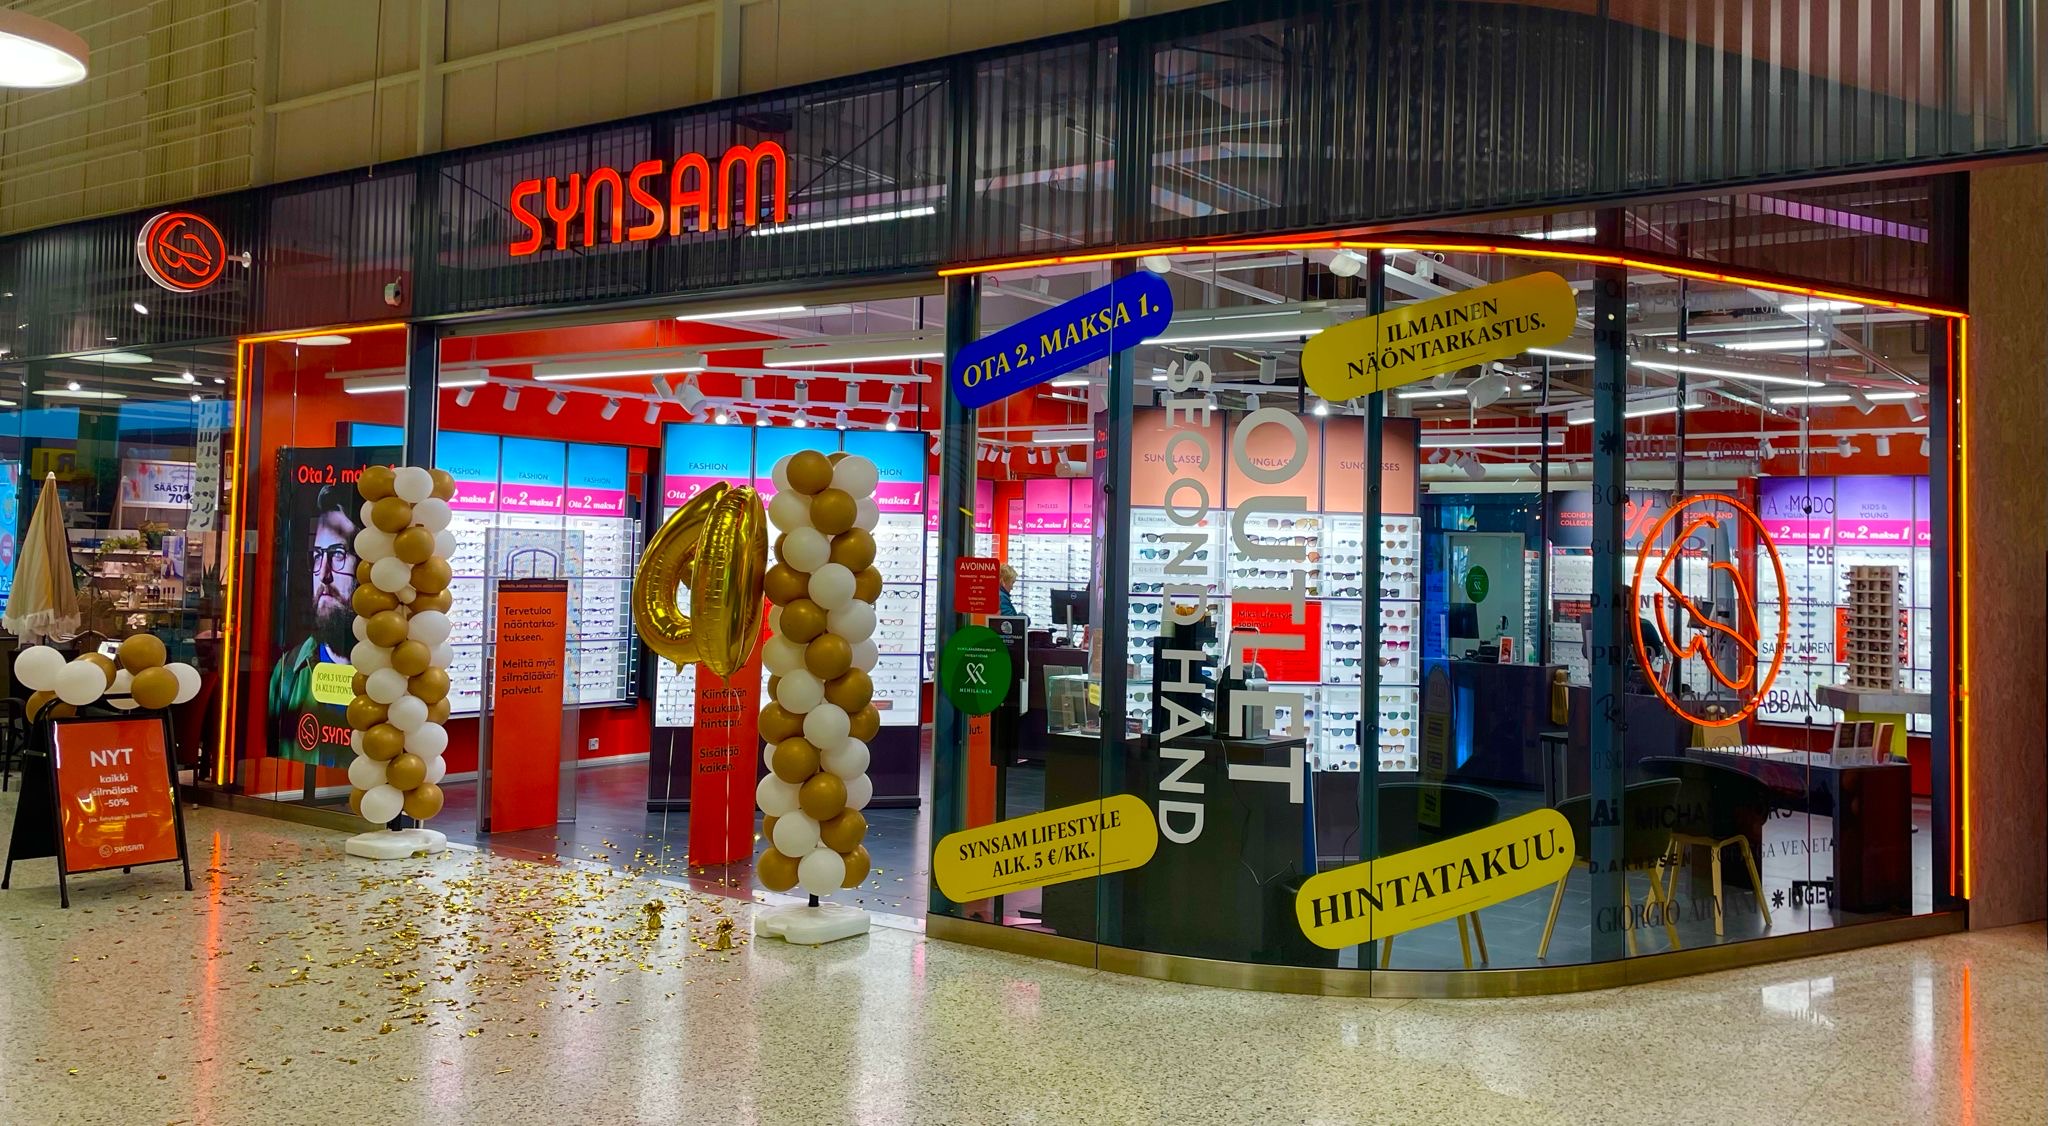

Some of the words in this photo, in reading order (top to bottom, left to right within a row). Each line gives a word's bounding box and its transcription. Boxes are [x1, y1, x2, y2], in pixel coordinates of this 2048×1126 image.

[509, 140, 788, 257] SYNSAM
[1386, 298, 1499, 343] ILMAINEN
[962, 352, 1011, 388] OTA
[1015, 343, 1035, 369] 2,
[1039, 302, 1131, 359] MAKSA
[1138, 292, 1159, 318] 1.
[1346, 312, 1546, 380] NÄÖNTARKASTUS.
[1144, 453, 1203, 464] SUNLASSE
[450, 467, 481, 476] FASHION
[689, 462, 728, 470] FASHION
[1340, 461, 1400, 471] SUNGSSES
[298, 465, 322, 484] Ota
[325, 464, 337, 486] 2,
[518, 472, 549, 481] FASHION
[583, 476, 611, 484] FASHION
[488, 490, 495, 504] 1
[667, 491, 687, 499] Ota
[688, 484, 701, 499] 2
[878, 496, 911, 505] maksa
[913, 491, 921, 506] 1
[1163, 359, 1212, 626] SECOND
[502, 497, 518, 505] Ota
[519, 491, 528, 506] 2
[530, 499, 554, 507] maksa
[555, 494, 563, 508] 1
[568, 501, 583, 509] Ota
[583, 496, 593, 509] 2
[594, 502, 616, 510] maksa
[617, 498, 624, 510] 1
[1037, 518, 1044, 529] 2
[1062, 519, 1068, 529] 1
[1083, 518, 1091, 529] 2
[1780, 525, 1791, 539] 2
[1823, 526, 1831, 540] 1
[1838, 532, 1855, 540] Ota
[1857, 525, 1869, 540] 2
[1870, 532, 1900, 540] maksa
[1901, 526, 1910, 540] 1
[960, 562, 997, 571] AVOINNA
[504, 606, 552, 616] Tervetuloa
[1228, 407, 1310, 804] OUTLET
[503, 619, 558, 629] näöntarkas-
[503, 633, 544, 642] tukseen.
[502, 658, 534, 669] Meiltä
[536, 657, 556, 669] myös
[502, 670, 558, 682] silmälääkäri-
[501, 685, 544, 697] palvelut.
[1756, 689, 1834, 714] ABBANA
[321, 725, 351, 746] SYNS
[699, 745, 739, 758] Sisältää
[1158, 648, 1207, 845] HAND
[89, 747, 134, 768] NYT
[699, 762, 735, 774] kaiken.
[99, 773, 129, 783] kaikki
[91, 785, 138, 797] silmälasit
[104, 798, 130, 807] -50%
[959, 830, 1028, 862] SYNSAM
[1031, 810, 1122, 846] LIFESTYLE
[993, 855, 1031, 878] ALK.
[1034, 852, 1044, 869] 5
[1047, 841, 1096, 866] €/KK.
[1311, 828, 1565, 928] HINTATAKUU.
[1596, 898, 1681, 935] GIORGIO
